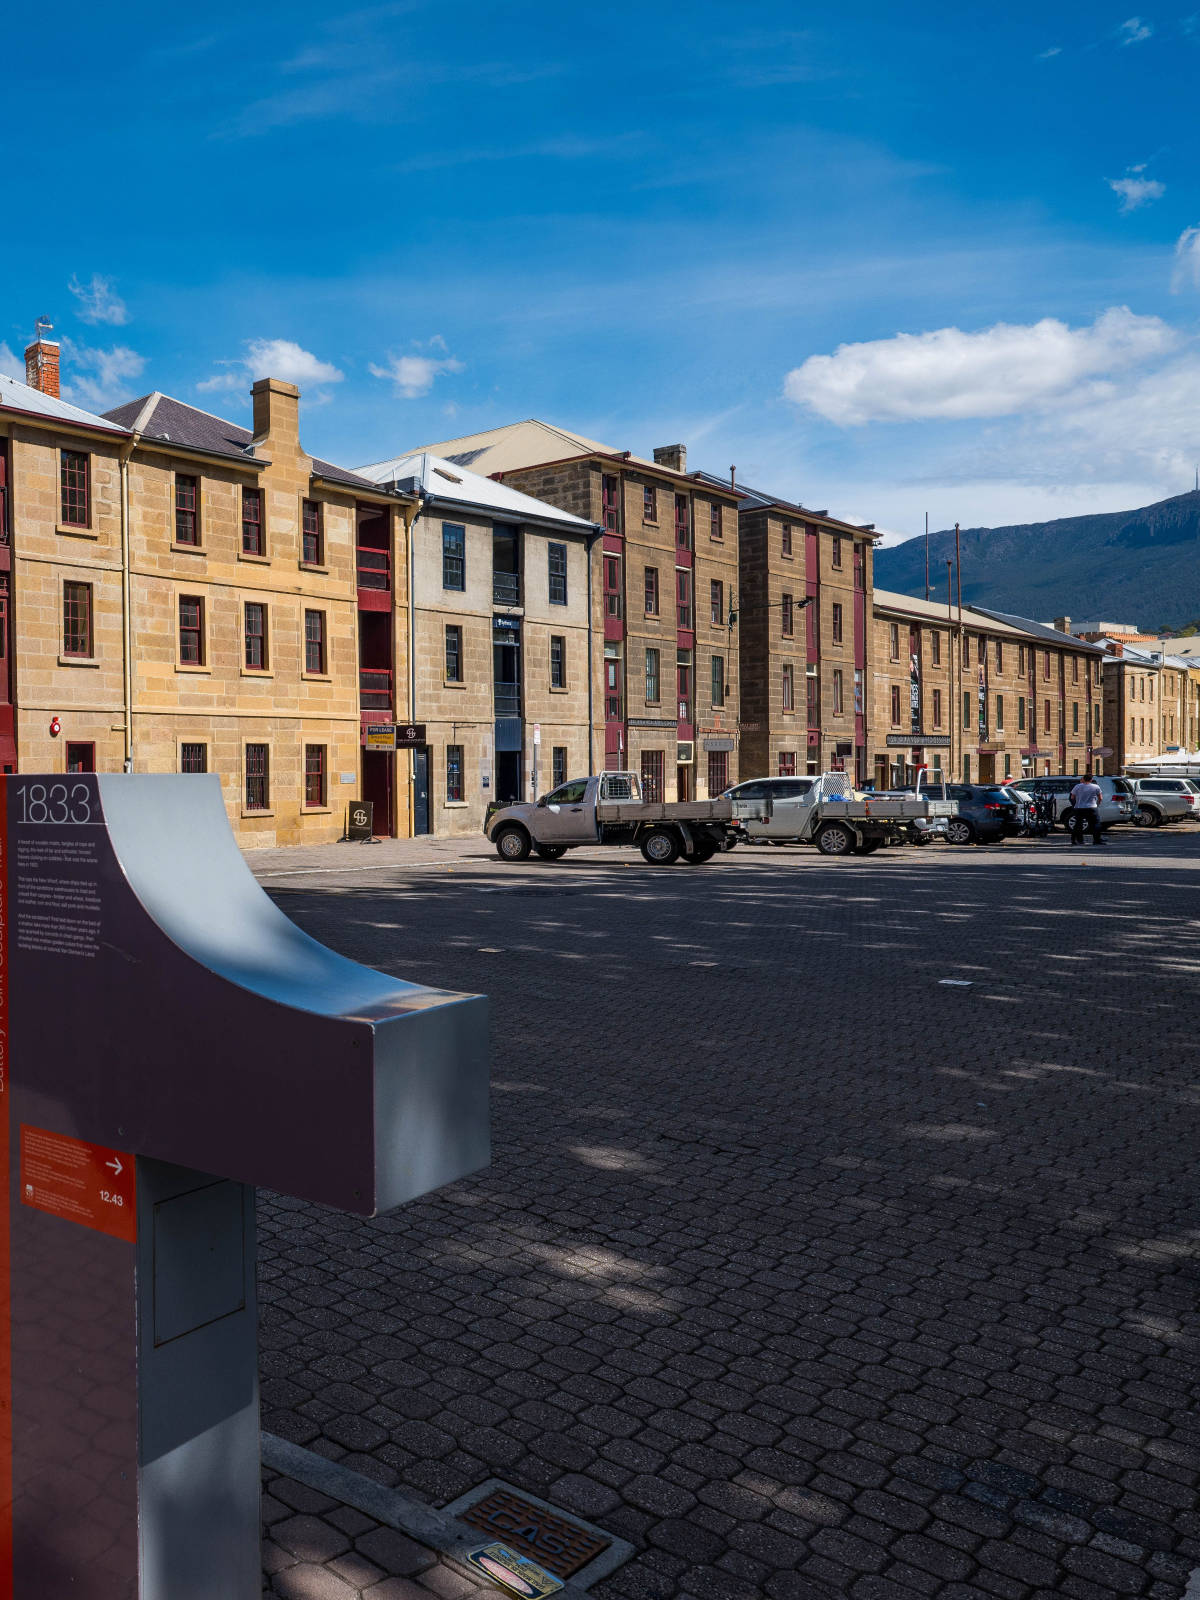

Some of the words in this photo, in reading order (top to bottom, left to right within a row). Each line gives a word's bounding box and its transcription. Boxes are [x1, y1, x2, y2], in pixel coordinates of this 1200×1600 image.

[17, 783, 91, 823] 1833
[99, 1190, 123, 1207] 12.43
[487, 1510, 571, 1555] GAS
